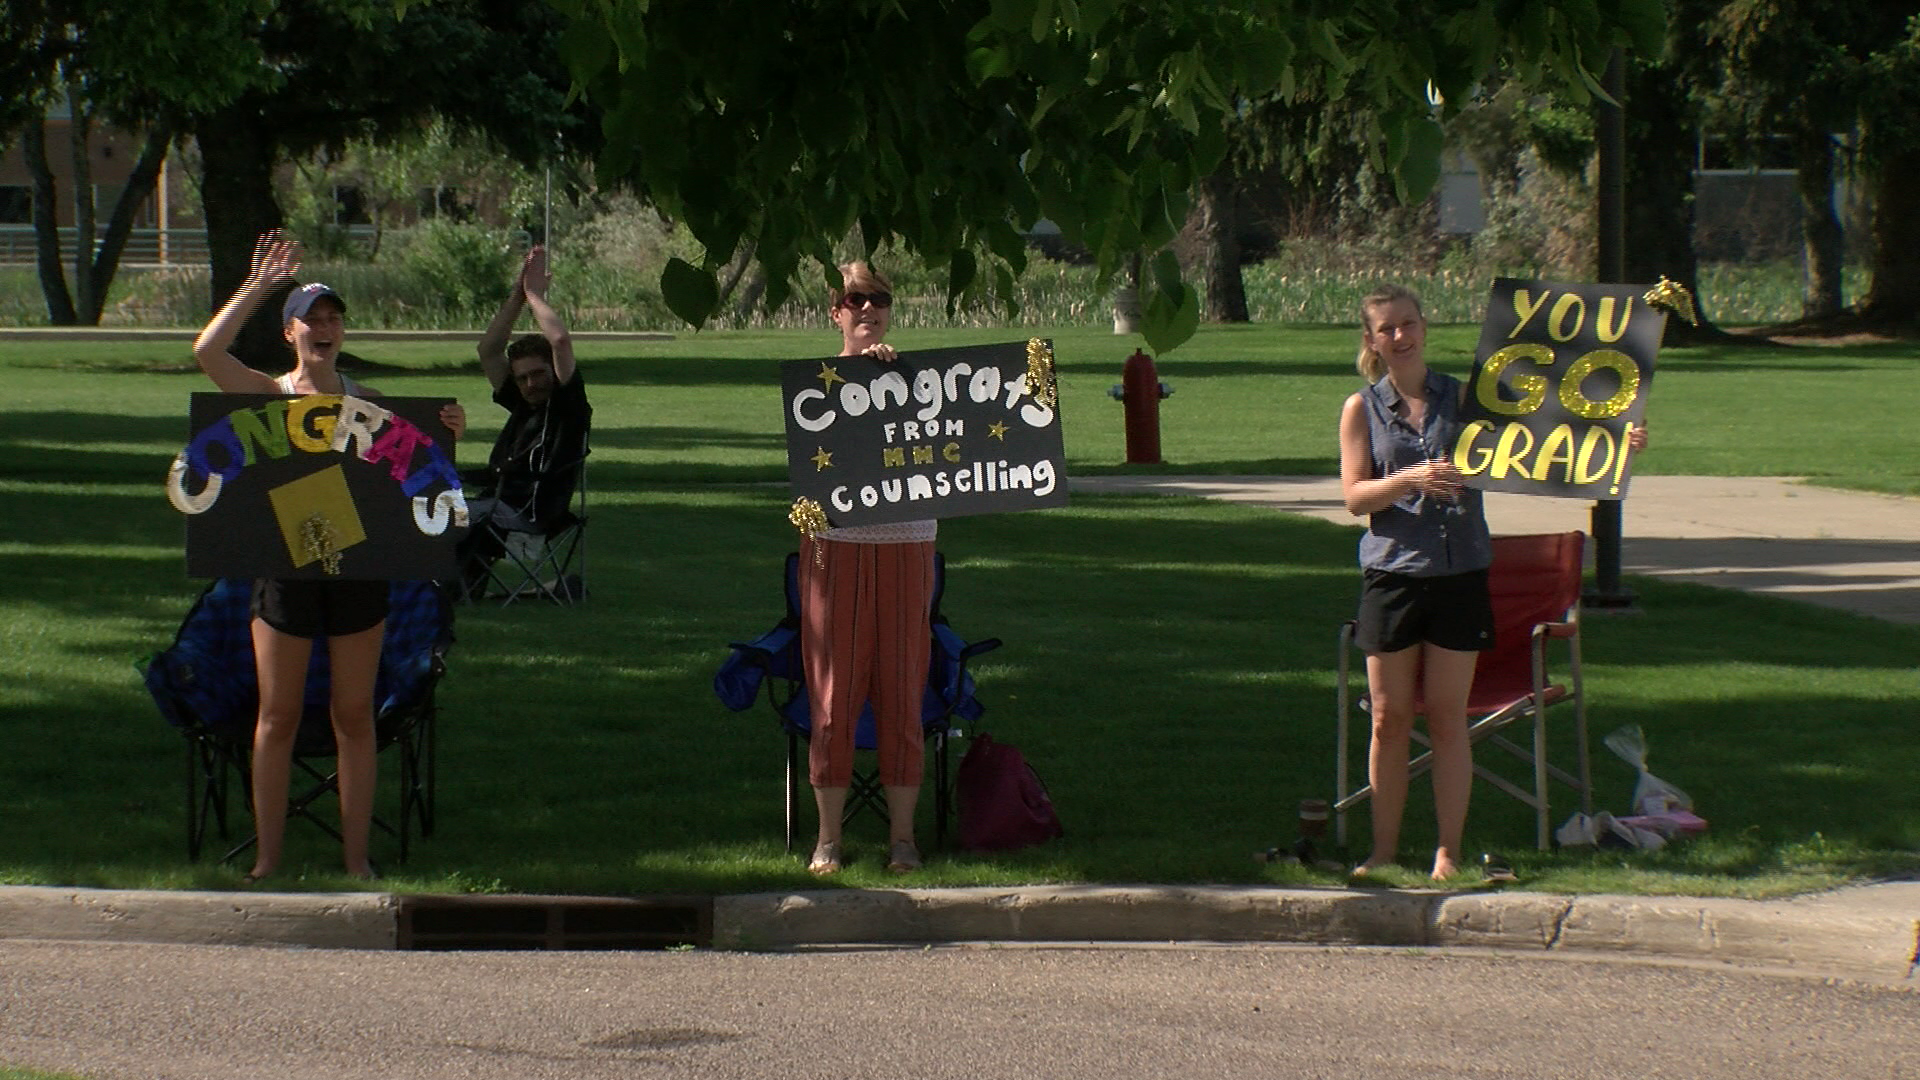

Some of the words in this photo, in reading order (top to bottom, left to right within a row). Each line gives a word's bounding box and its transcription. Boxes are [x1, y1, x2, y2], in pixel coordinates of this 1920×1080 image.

[1508, 289, 1633, 343] YOU
[1476, 343, 1640, 419] GO
[883, 419, 964, 443] FROM
[883, 442, 961, 468] MMC
[1454, 420, 1634, 495] GRAD!
[167, 395, 470, 536] CONGRATS
